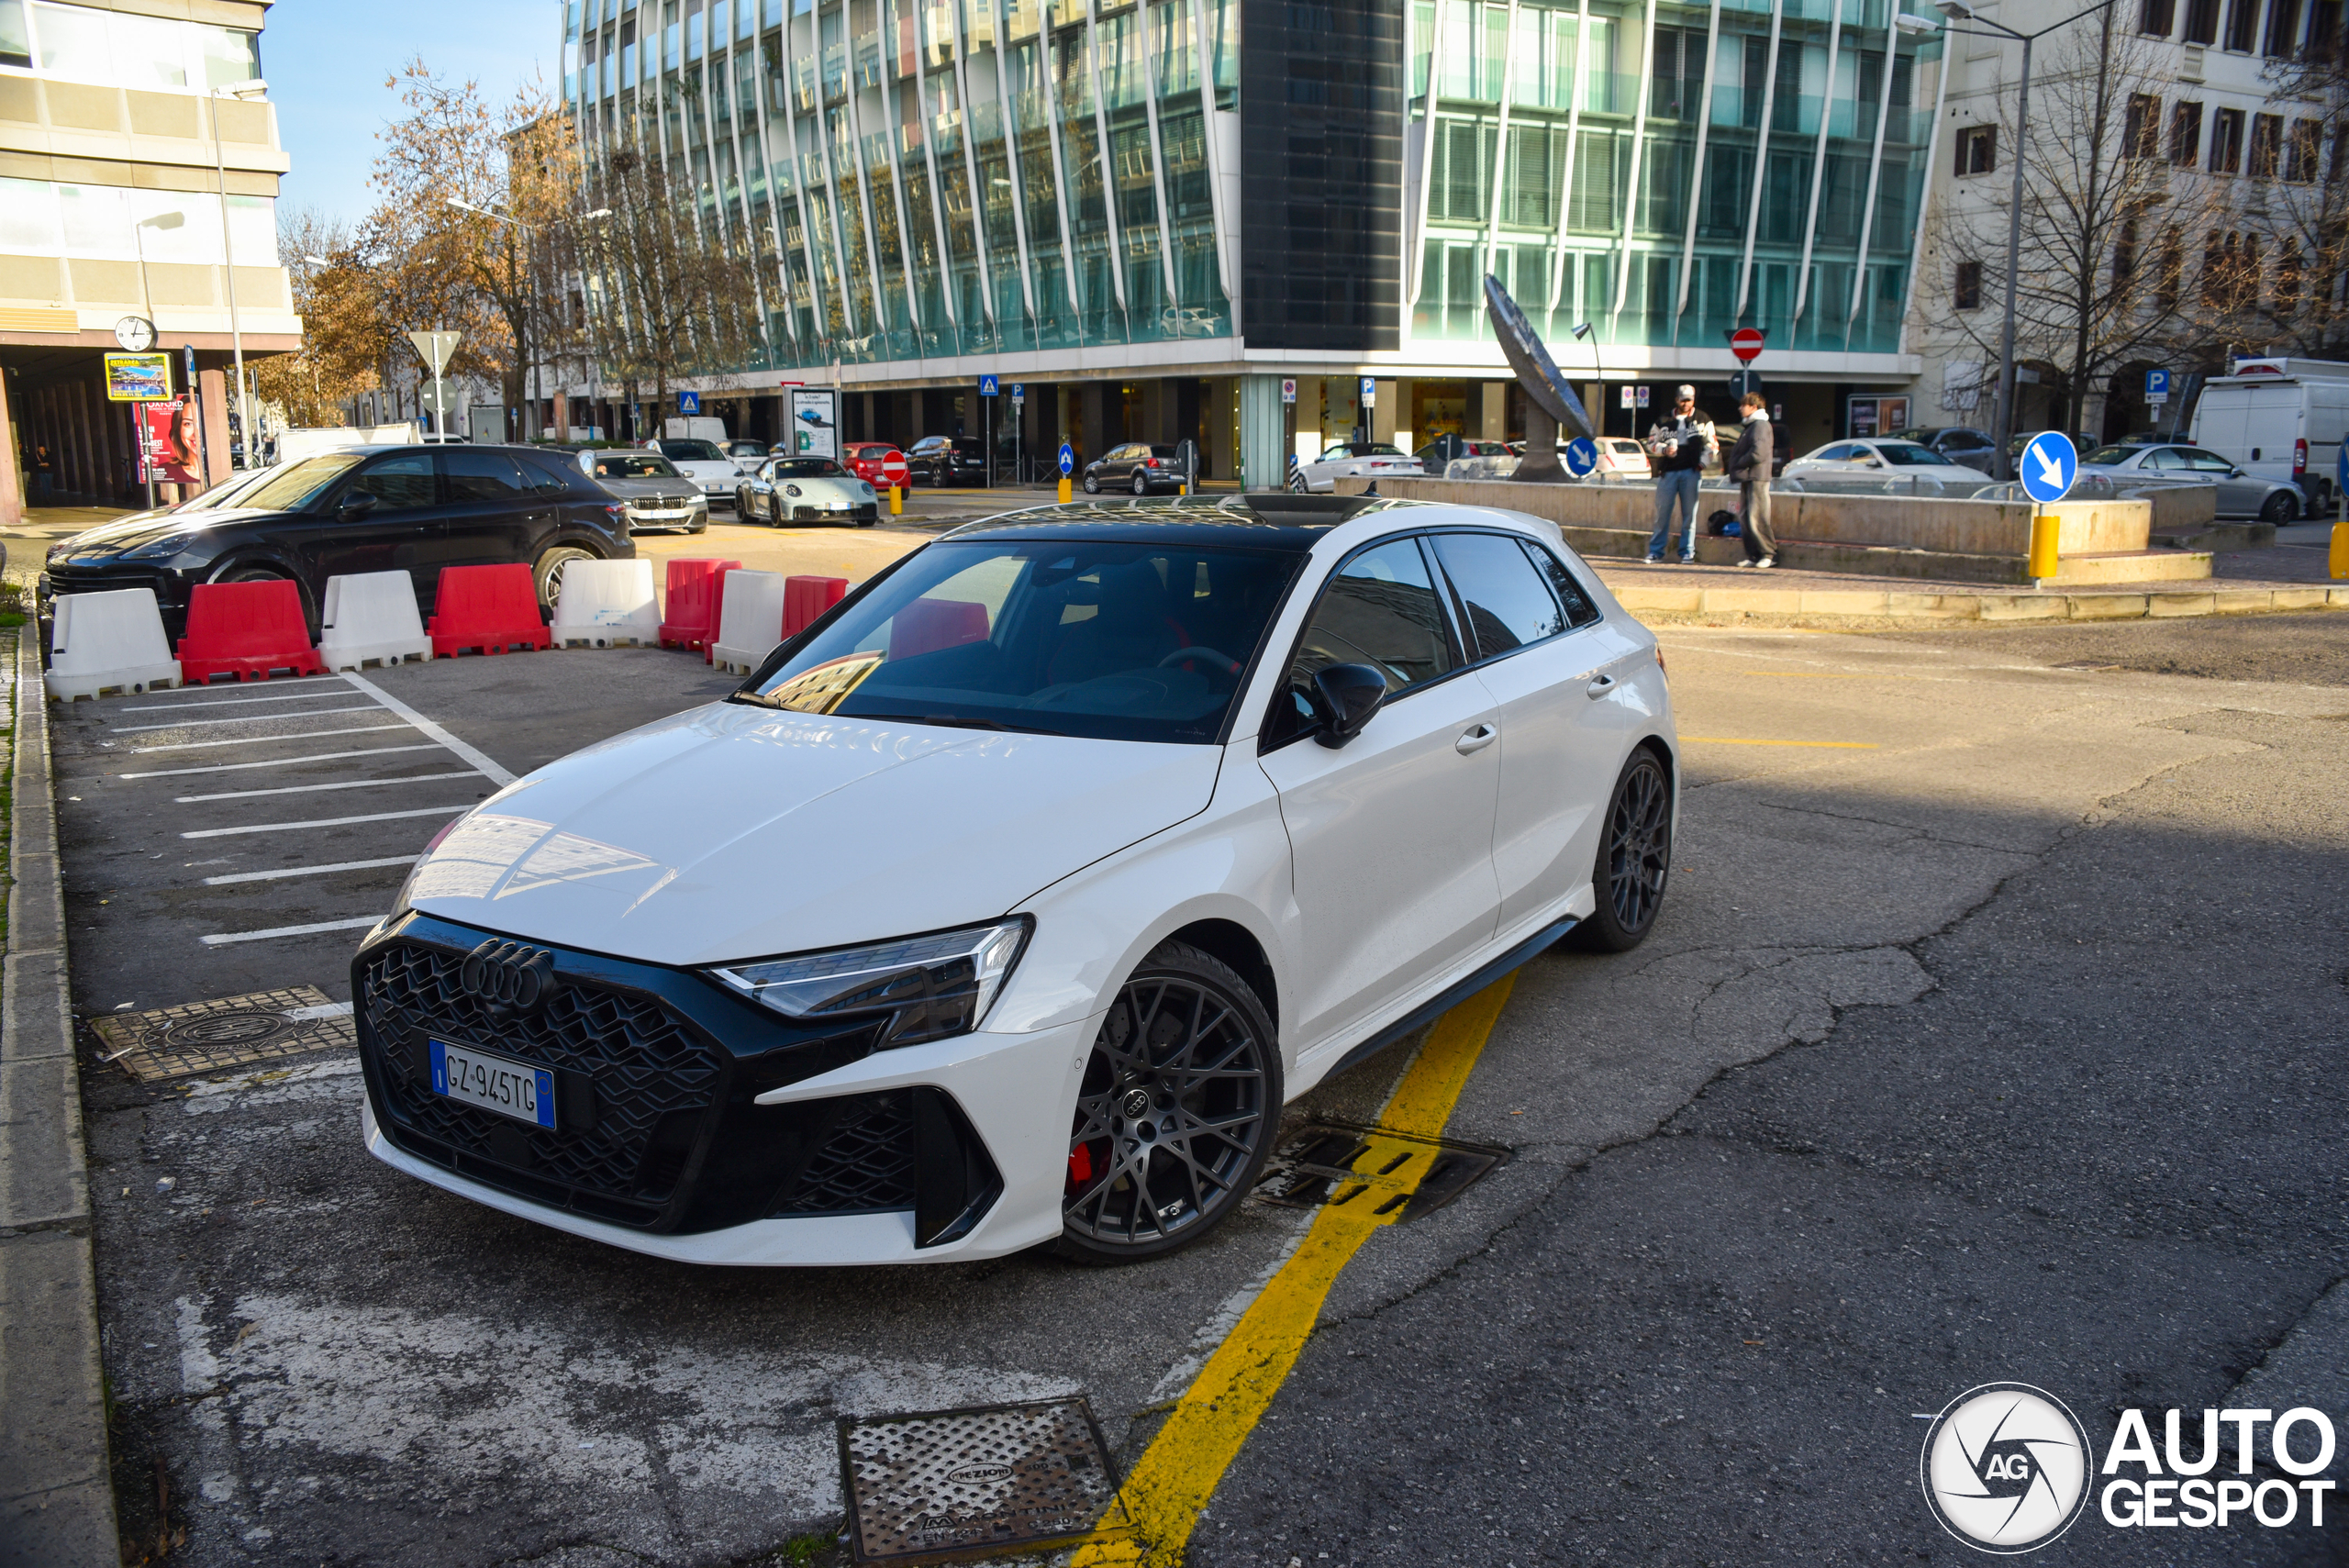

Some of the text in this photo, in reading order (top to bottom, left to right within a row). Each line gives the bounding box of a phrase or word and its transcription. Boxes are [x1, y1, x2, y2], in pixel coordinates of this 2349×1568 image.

[1364, 379, 1372, 392] P
[2150, 373, 2164, 390] P
[1014, 384, 1021, 395] P
[958, 1504, 1066, 1522] MONTINI
